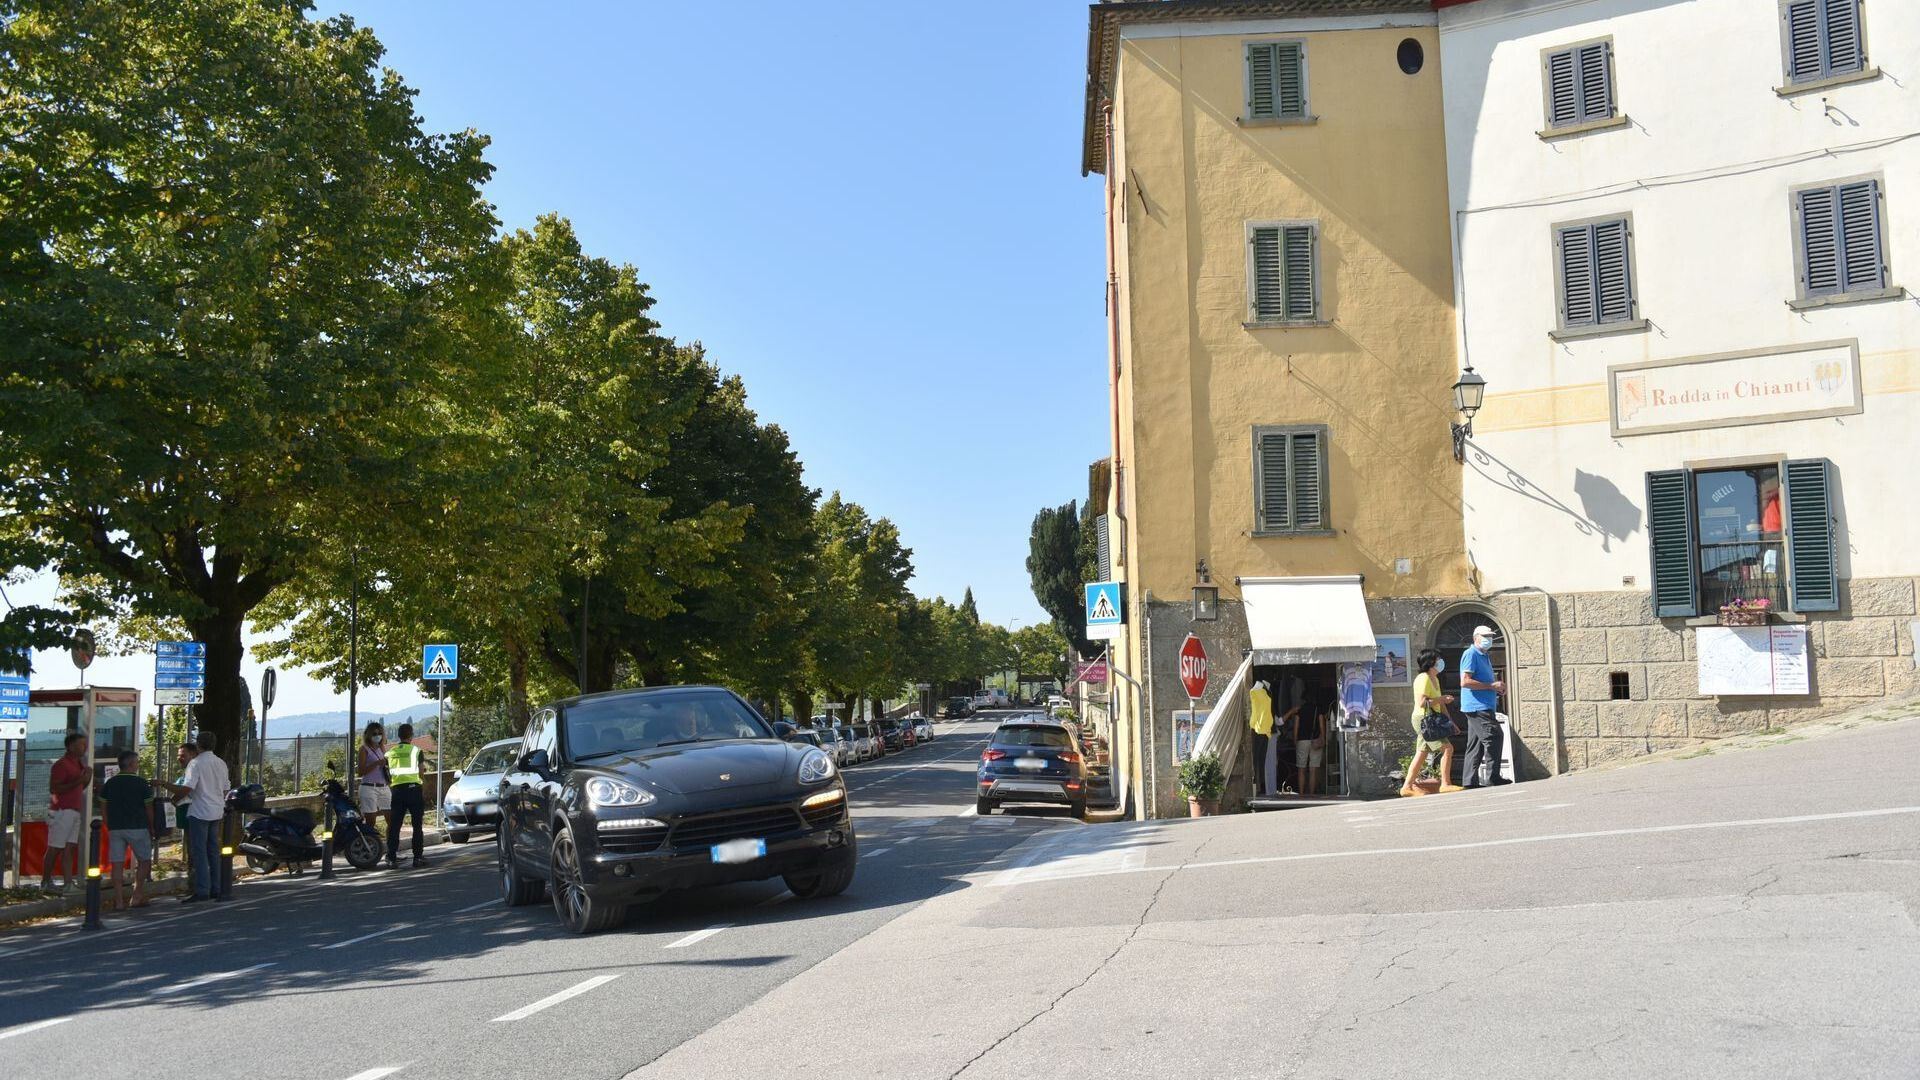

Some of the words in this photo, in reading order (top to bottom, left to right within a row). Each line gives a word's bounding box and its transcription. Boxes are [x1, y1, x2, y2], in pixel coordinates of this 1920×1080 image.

[1652, 388, 1711, 406] Radda
[1716, 389, 1730, 400] in
[1734, 377, 1811, 398] Chianti
[1182, 655, 1206, 679] STOP
[2, 688, 24, 697] CHIANTI
[0, 706, 21, 716] PAIA
